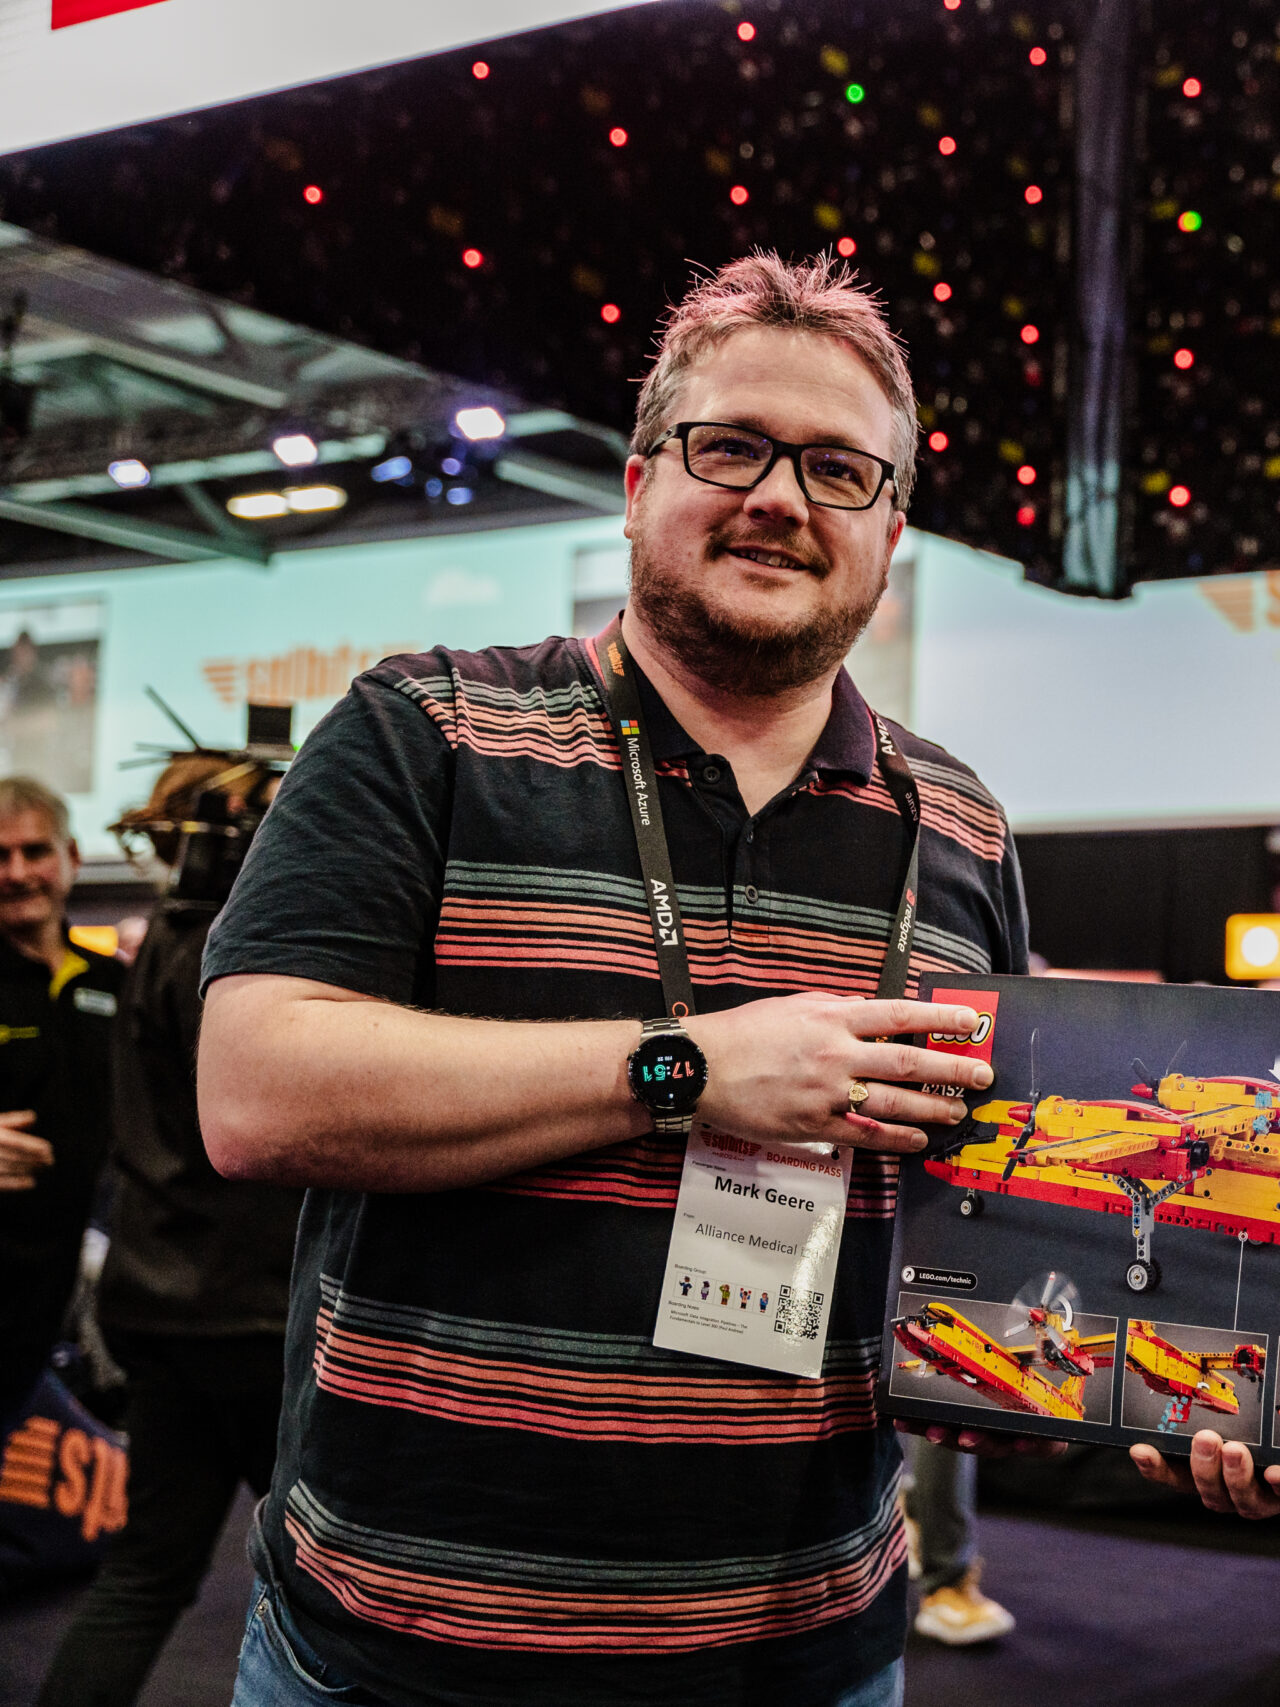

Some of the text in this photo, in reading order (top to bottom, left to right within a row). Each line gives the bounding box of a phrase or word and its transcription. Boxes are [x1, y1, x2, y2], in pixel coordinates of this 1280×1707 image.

[627, 738, 651, 826] Microsoft Azure
[651, 879, 674, 931] AMD
[897, 904, 912, 952] redgate
[643, 1061, 695, 1082] 17:51
[921, 1083, 965, 1098] 42152
[766, 1151, 842, 1178] BOARDING PASS
[714, 1176, 815, 1212] Mark Geere
[695, 1223, 745, 1244] Alliance
[748, 1235, 798, 1256] Medical
[919, 1272, 972, 1285] LEGO.com/technic
